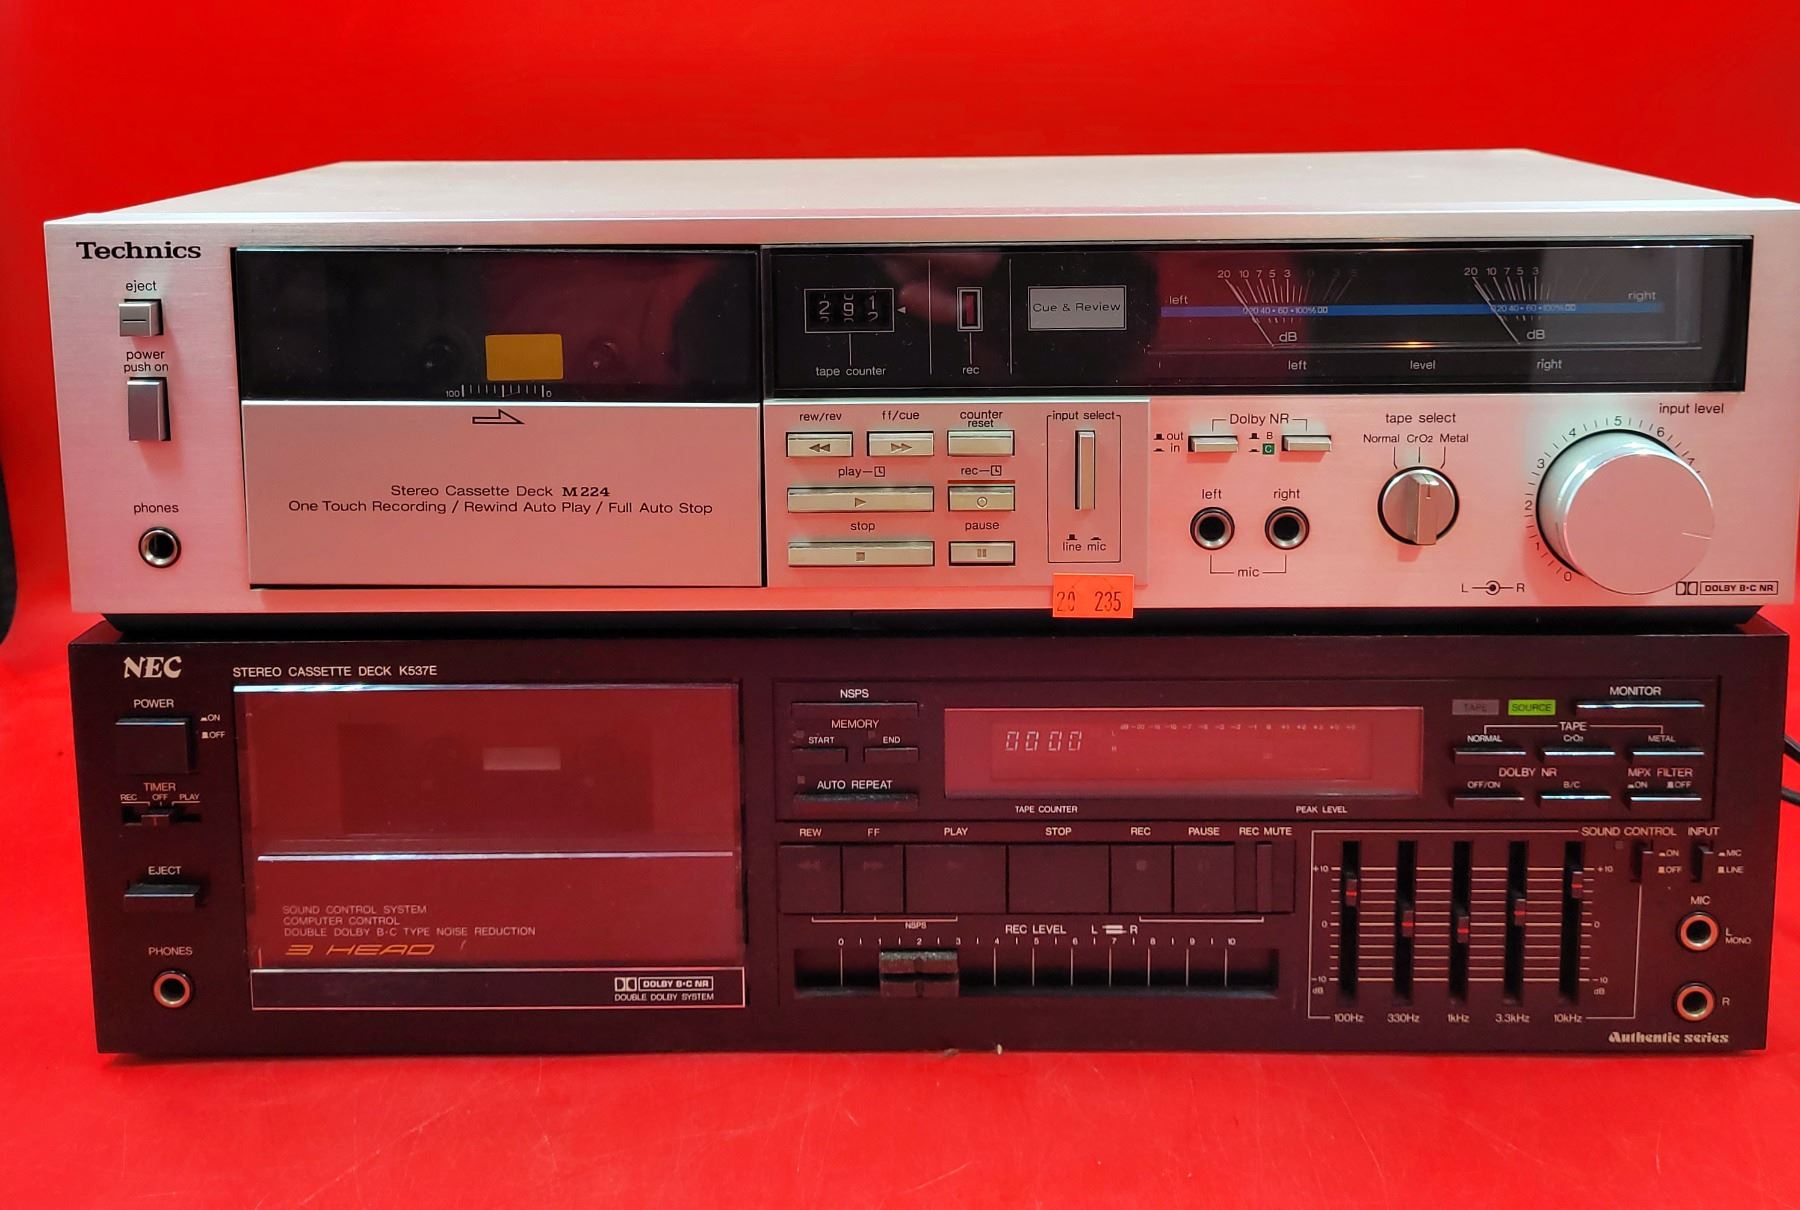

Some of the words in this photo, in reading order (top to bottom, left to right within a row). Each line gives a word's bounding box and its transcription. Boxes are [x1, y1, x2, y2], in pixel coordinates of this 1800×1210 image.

[76, 241, 202, 260] Technics
[1217, 269, 1231, 279] 20
[1240, 269, 1250, 279] 10
[1464, 267, 1479, 276] 20
[1486, 267, 1497, 276] 10
[125, 280, 157, 293] eject
[1169, 294, 1188, 305] left
[1628, 290, 1656, 302] right
[1032, 302, 1058, 313] Cue
[1062, 302, 1071, 313] &
[1075, 302, 1121, 313] Review
[1279, 331, 1298, 343] dB
[1526, 329, 1545, 340] dB
[126, 350, 165, 363] power
[123, 361, 151, 373] push
[154, 362, 169, 372] on
[1288, 359, 1307, 370] left
[1410, 359, 1436, 370] level
[1536, 358, 1562, 372] right
[815, 366, 841, 378] tape
[845, 366, 887, 377] counter
[962, 365, 980, 375] rec
[445, 389, 460, 398] 100
[1659, 402, 1690, 415] input
[1694, 402, 1724, 414] level
[799, 411, 842, 422] rew/rev
[960, 409, 1003, 420] counter
[1052, 409, 1080, 422] input
[1083, 409, 1116, 421] select
[1385, 413, 1413, 425] tape
[1418, 412, 1456, 424] select
[967, 418, 994, 428] reset
[1229, 413, 1266, 427] Dolby
[1270, 413, 1289, 425] NR
[1166, 432, 1184, 441] out
[1363, 433, 1400, 443] Normal
[1439, 433, 1469, 443] Metal
[1170, 443, 1181, 453] in
[1524, 500, 1533, 511] 2
[1536, 458, 1545, 469] 3
[1568, 427, 1577, 438] 4
[1614, 416, 1623, 427] 5
[1656, 426, 1665, 438] 6
[838, 467, 862, 479] play
[961, 466, 980, 476] rec
[391, 484, 439, 497] Stereo
[445, 484, 510, 497] Cassette
[516, 485, 553, 497] Deck
[1201, 488, 1222, 500] left
[1273, 488, 1300, 502] right
[133, 502, 180, 515] phones
[288, 499, 319, 512] One
[322, 499, 367, 512] Touch
[372, 500, 447, 514] Recording
[451, 499, 459, 514] /
[464, 500, 518, 513] Rewind
[523, 501, 557, 513] Auto
[561, 501, 592, 515] Play
[595, 500, 603, 515] /
[608, 501, 633, 513] Full
[639, 502, 673, 514] Auto
[679, 502, 713, 516] Stop
[850, 521, 876, 533] stop
[965, 521, 1000, 533] pause
[1062, 542, 1082, 552] line
[1087, 542, 1107, 552] mic
[1237, 566, 1260, 577] mic
[1704, 584, 1737, 592] DOLBY
[1056, 591, 1076, 611] 20
[1094, 591, 1122, 612] 235
[123, 656, 182, 679] NEC
[233, 666, 282, 678] STEREO
[288, 666, 352, 677] CASSETTE
[358, 665, 392, 677] DECK
[399, 665, 437, 676] K537E
[840, 688, 869, 699] NSPS
[1609, 686, 1662, 696] MONITOR
[133, 698, 175, 709] POWER
[1463, 703, 1488, 712] TAPE
[1511, 703, 1552, 713] SOURCE
[831, 719, 880, 729] MEMORY
[1559, 722, 1587, 731] TAPE
[209, 731, 226, 739] OFF
[808, 736, 835, 744] START
[883, 736, 901, 744] END
[1467, 735, 1503, 743] NORMAL
[1648, 735, 1676, 743] METAL
[1005, 731, 1083, 751] 0000
[1498, 767, 1536, 777] DOLBY
[1541, 768, 1558, 777] NR
[1628, 768, 1651, 777] MPX
[1657, 768, 1693, 777] FILTER
[143, 782, 176, 792] TIMER
[817, 780, 846, 790] AUTO
[851, 780, 893, 789] REPEAT
[1467, 781, 1501, 789] OFF/ON
[120, 793, 138, 801] REC
[179, 793, 200, 801] PLAY
[1015, 806, 1035, 814] TAPE
[1038, 805, 1078, 814] COUNTER
[1295, 805, 1318, 814] PEAK
[1322, 805, 1348, 814] LEVEL
[800, 828, 822, 837] REW
[867, 828, 880, 837] FF
[943, 827, 969, 837] PLAY
[1045, 827, 1072, 836] STOP
[1130, 827, 1151, 836] REC
[1188, 827, 1220, 836] PAUSE
[1239, 827, 1260, 836] REC
[1263, 827, 1292, 836] MUTE
[1581, 826, 1621, 836] SOUND
[1624, 826, 1677, 836] CONTROL
[1688, 826, 1720, 836] INPUT
[148, 866, 182, 876] EJECT
[1690, 896, 1710, 905] MIC
[282, 905, 320, 915] SOUND
[326, 905, 376, 915] CONTROL
[383, 904, 427, 914] SYSTEM
[283, 916, 343, 926] COMPUTER
[348, 916, 400, 926] CONTROL
[284, 927, 327, 937] DOUBLE
[334, 927, 370, 937] DOLBY
[404, 927, 431, 936] TYPE
[436, 927, 468, 936] NOISE
[474, 926, 536, 936] REDUCTION
[1005, 925, 1028, 935] REC
[1032, 925, 1067, 935] LEVEL
[1725, 937, 1751, 945] MONO
[148, 946, 193, 956] PHONES
[285, 944, 313, 955] 3
[327, 944, 435, 955] HEAD
[643, 980, 673, 988] DOLBY
[614, 993, 647, 1001] DOUBLE
[650, 993, 677, 1001] DOLBY
[681, 992, 714, 1001] SYSTEM
[1334, 1013, 1364, 1022] 100Hz
[1387, 1013, 1420, 1022] 330Hz
[1447, 1013, 1470, 1022] 1kHz
[1495, 1013, 1530, 1022] 3.3kHz
[1553, 1013, 1583, 1023] 10kHz
[1608, 1031, 1680, 1044] Authentic
[1684, 1032, 1729, 1043] series
